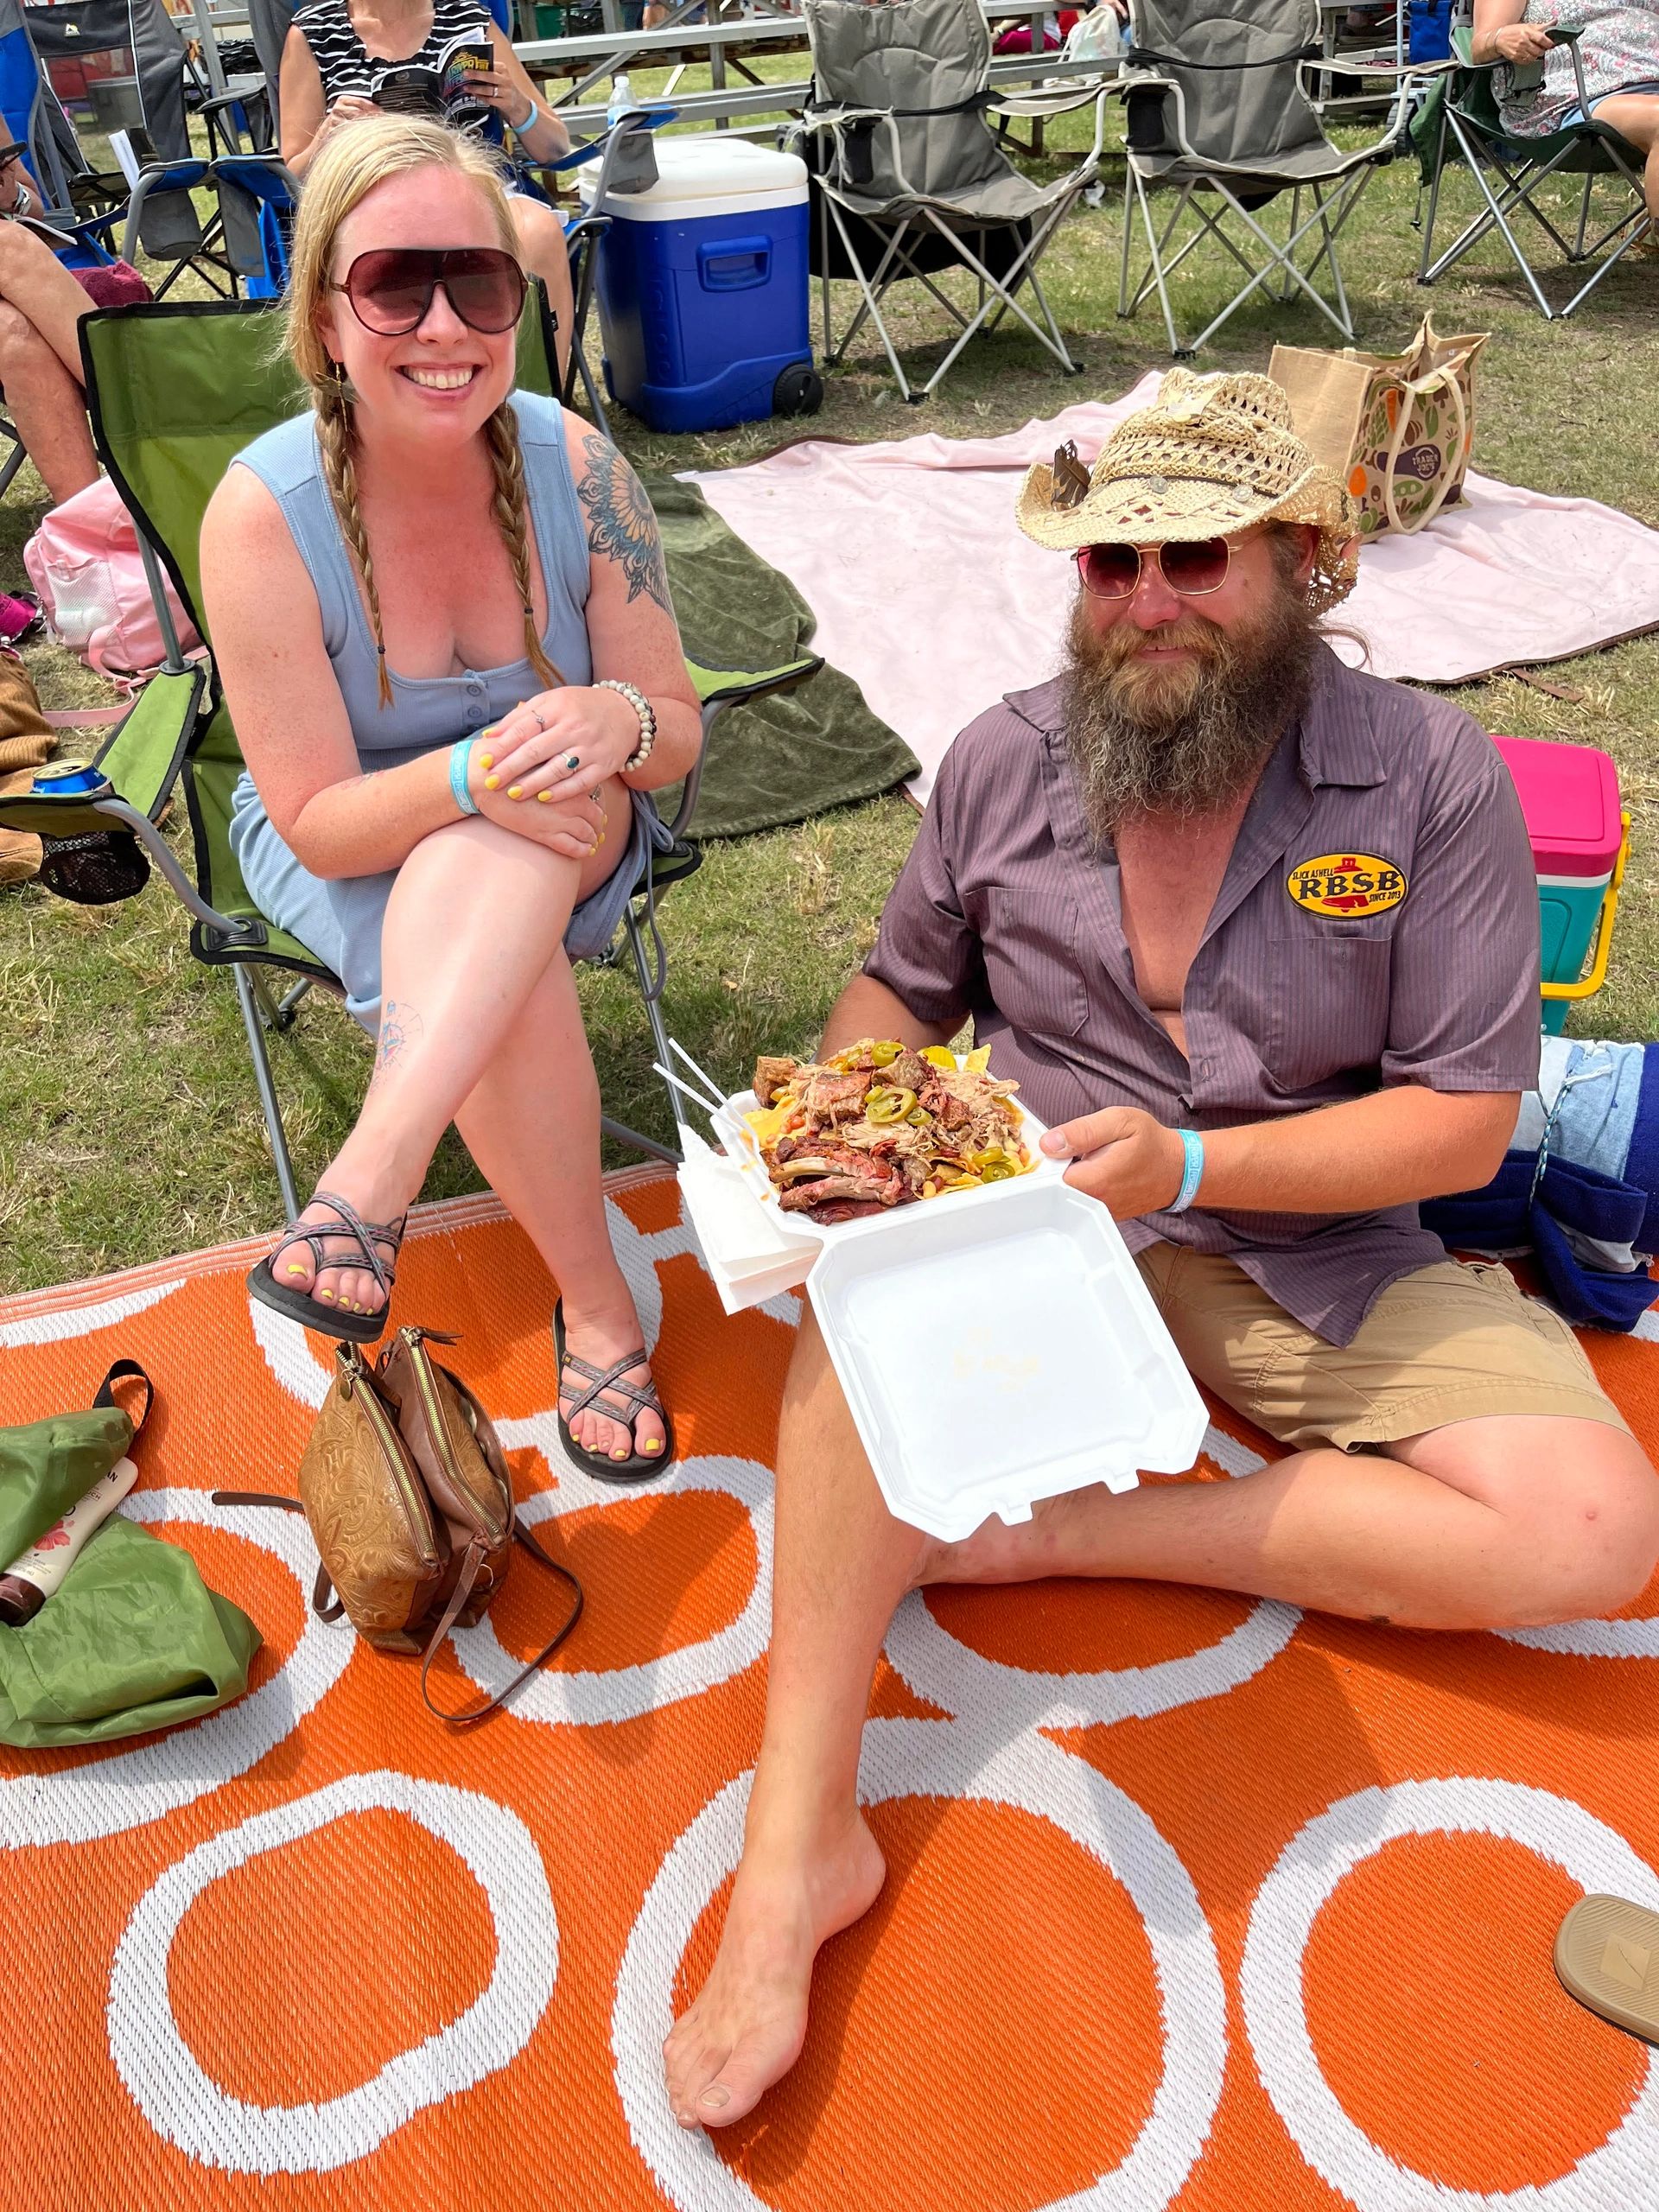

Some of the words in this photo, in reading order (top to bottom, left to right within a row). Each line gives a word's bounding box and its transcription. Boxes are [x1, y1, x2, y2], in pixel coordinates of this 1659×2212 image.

[1412, 454, 1439, 466] TRADER
[1293, 871, 1310, 880] SLICK
[1298, 870, 1401, 900] RBSB
[1369, 892, 1386, 903] SINCE
[1387, 890, 1402, 899] 2013
